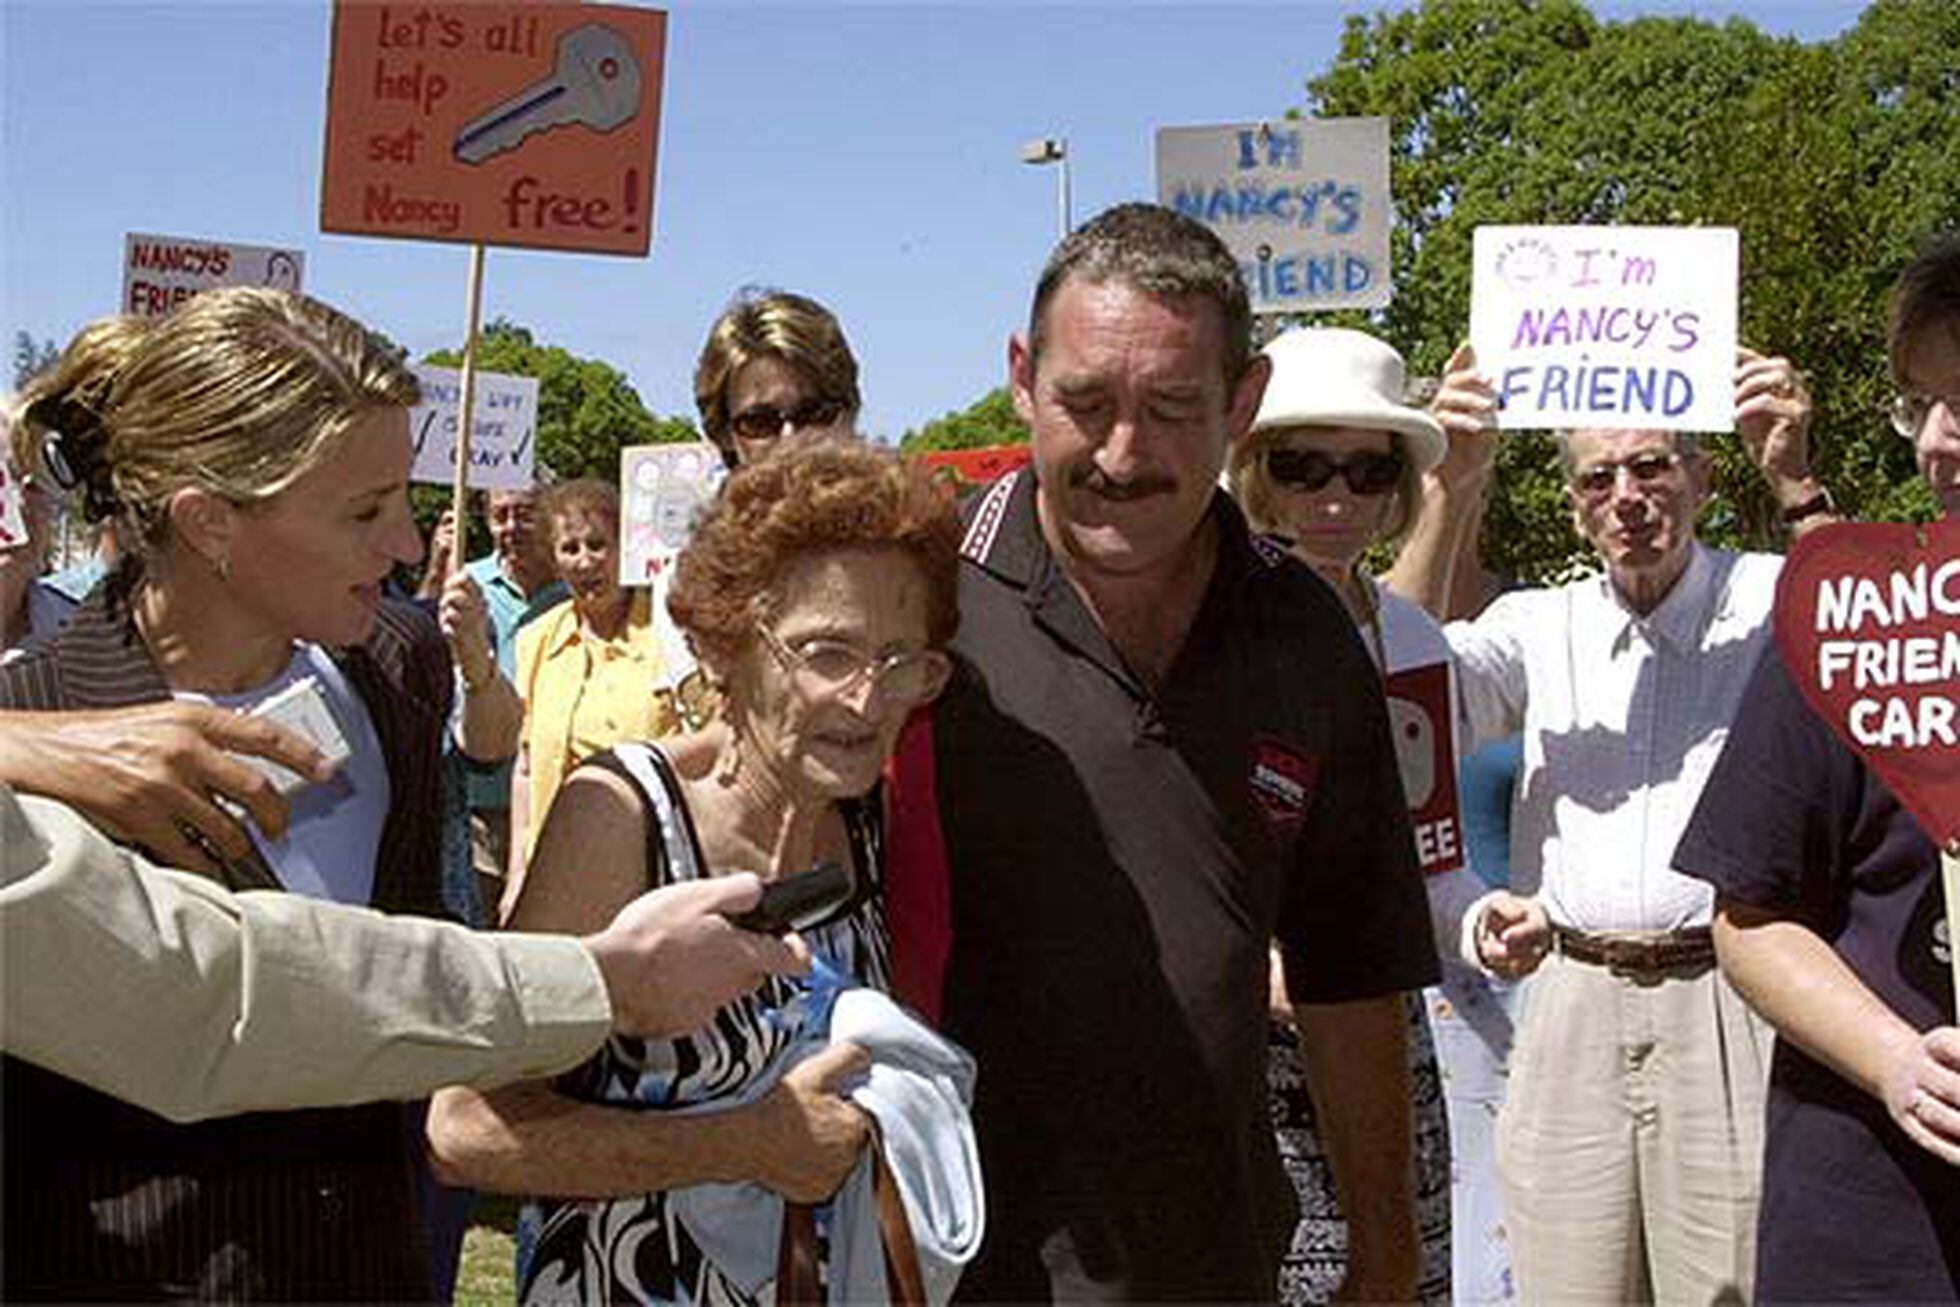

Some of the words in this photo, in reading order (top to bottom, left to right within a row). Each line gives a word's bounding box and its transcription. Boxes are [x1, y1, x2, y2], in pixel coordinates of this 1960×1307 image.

[377, 7, 465, 49] Let's
[484, 17, 537, 58] all
[373, 58, 448, 116] help
[367, 125, 423, 165] set
[363, 182, 462, 232] Nancy
[503, 167, 640, 234] free!
[1571, 248, 1657, 287] I'm
[130, 280, 197, 316] FRIE
[1510, 306, 1700, 352] NANCY'S
